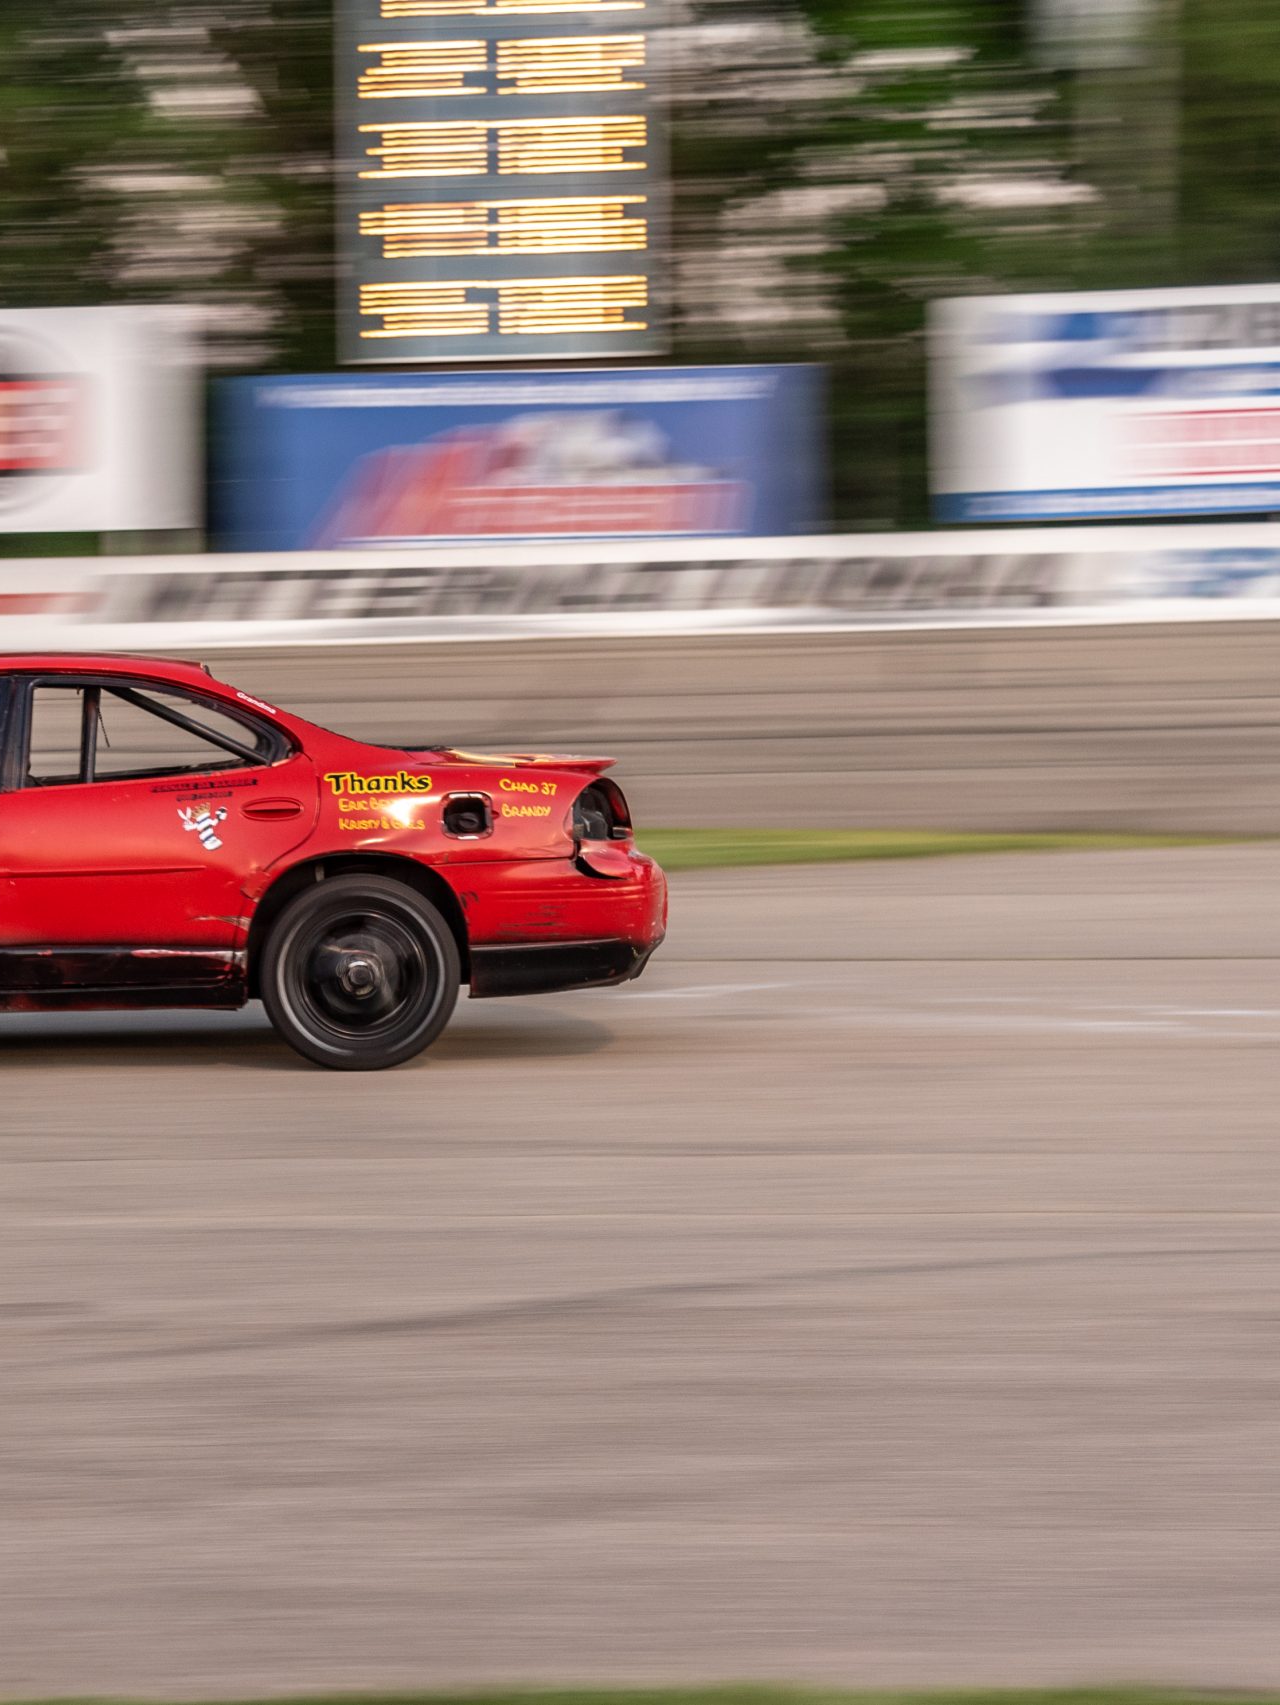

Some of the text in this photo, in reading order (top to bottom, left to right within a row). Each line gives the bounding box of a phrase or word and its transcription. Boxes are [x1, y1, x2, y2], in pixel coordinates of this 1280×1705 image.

[324, 771, 432, 795] Thanks
[541, 782, 558, 796] 37
[501, 803, 552, 818] BRANDY
